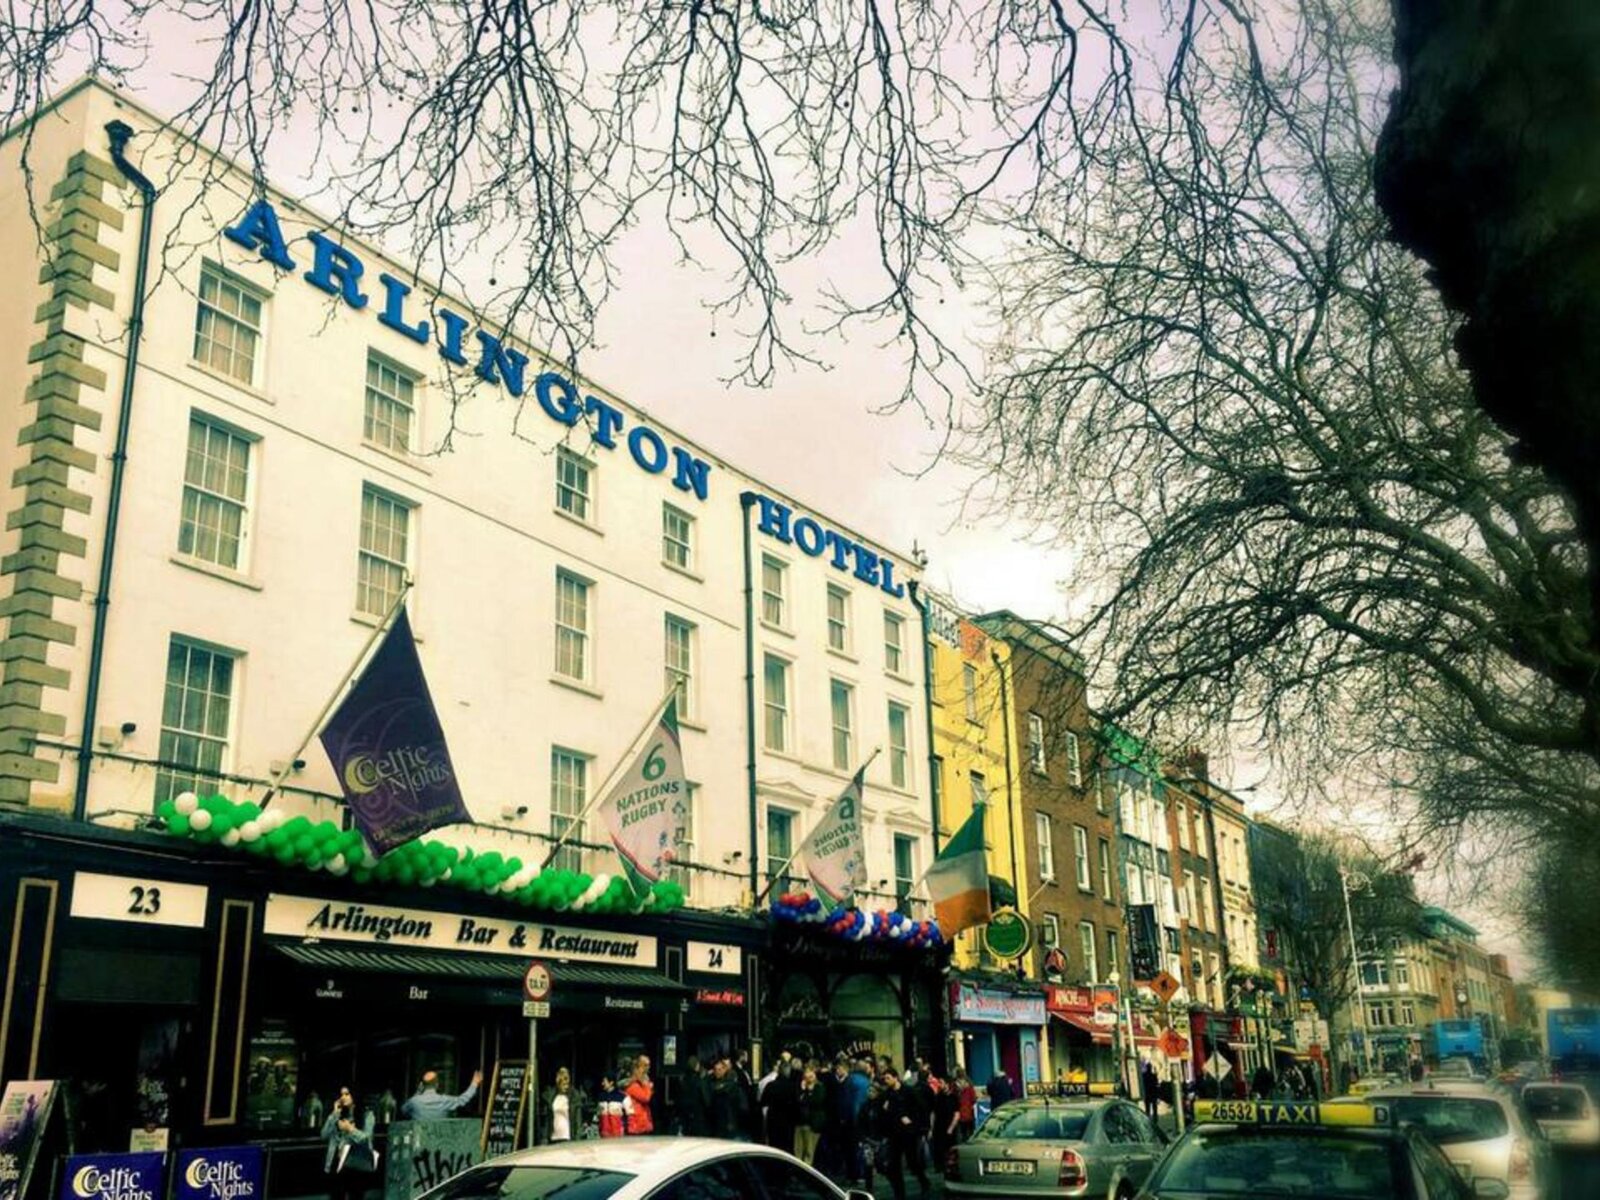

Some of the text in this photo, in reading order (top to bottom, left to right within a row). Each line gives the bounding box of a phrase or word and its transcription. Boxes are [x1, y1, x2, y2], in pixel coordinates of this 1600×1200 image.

[223, 199, 904, 598] ARLINGTON HOTEL
[356, 746, 430, 785] Celtic
[642, 743, 666, 781] 6
[388, 764, 450, 800] Nights
[616, 781, 680, 812] NATIONS
[621, 798, 667, 828] RUGBY
[127, 885, 161, 915] 23
[306, 903, 640, 959] Arlington Bar & Restaurant
[708, 947, 723, 967] 24
[409, 986, 428, 1000] Bar
[605, 997, 643, 1009] Restaurant
[1063, 1085, 1086, 1094] TAXI
[1211, 1103, 1253, 1121] 26532
[1259, 1105, 1316, 1123] TAXI
[83, 1168, 141, 1192] Celtic
[195, 1160, 243, 1182] Celtic
[211, 1180, 254, 1199] Nights
